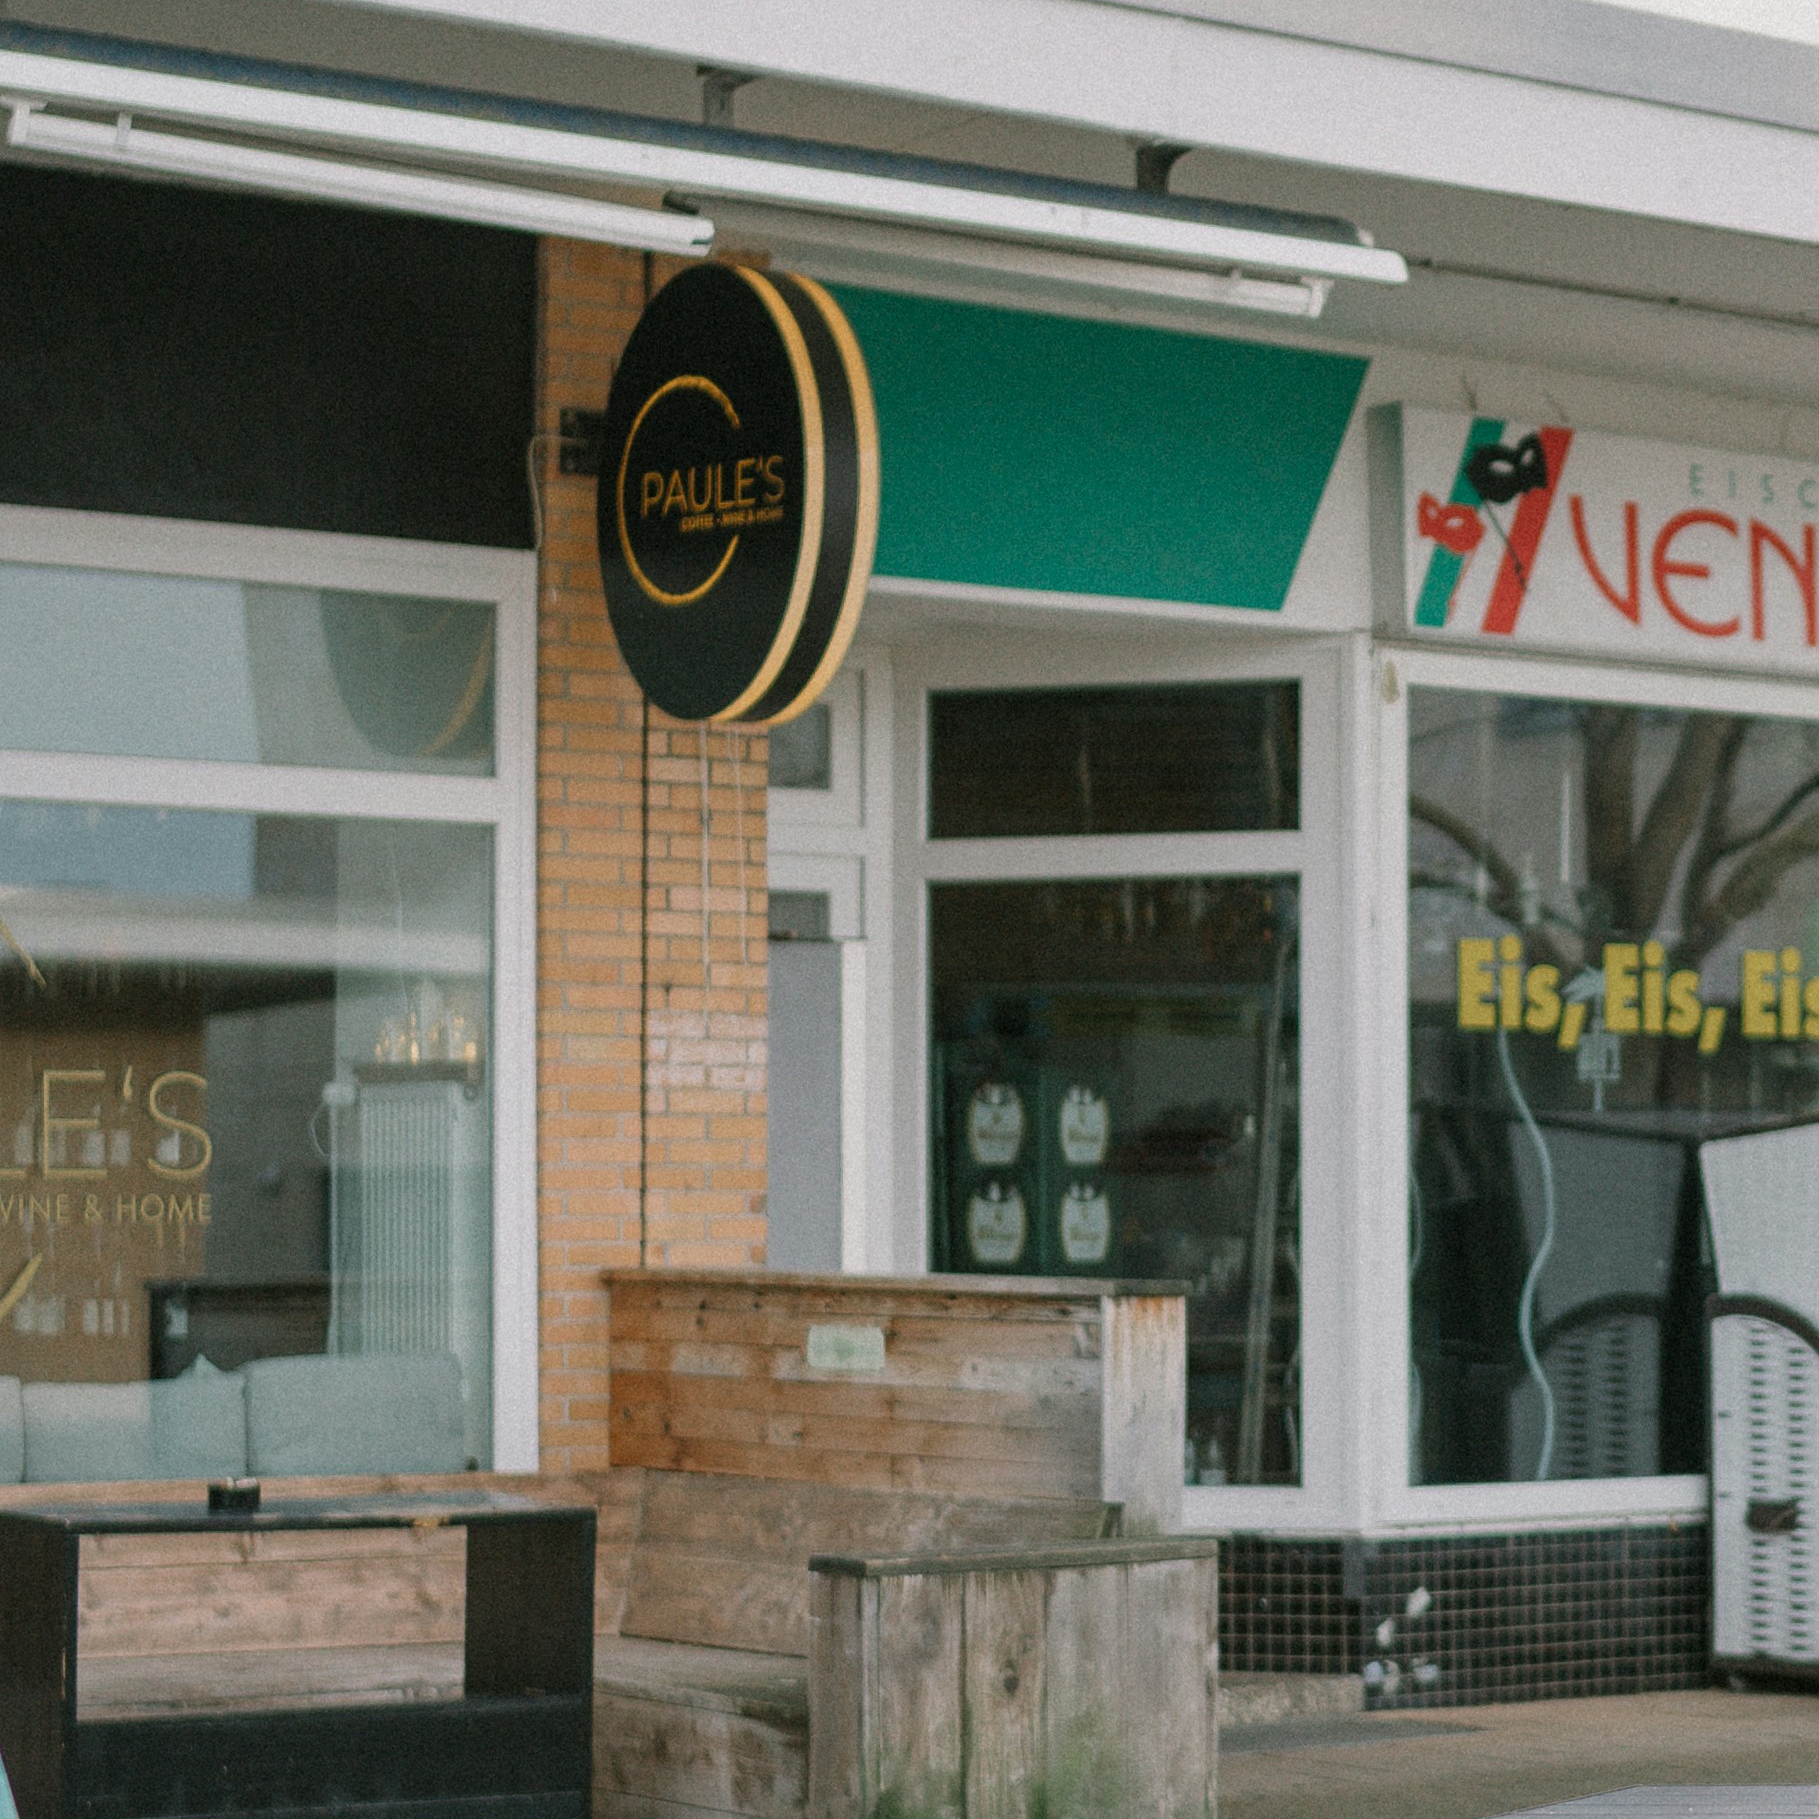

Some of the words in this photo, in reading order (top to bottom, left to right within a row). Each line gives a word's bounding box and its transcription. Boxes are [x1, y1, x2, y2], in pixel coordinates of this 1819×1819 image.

[640, 454, 785, 518] PAULE'S
[1457, 934, 1586, 1052] Eis,
[1603, 940, 1727, 1054] Eis,
[0, 1065, 213, 1179] E'S
[84, 1193, 103, 1221] &
[116, 1193, 213, 1223] HOME
